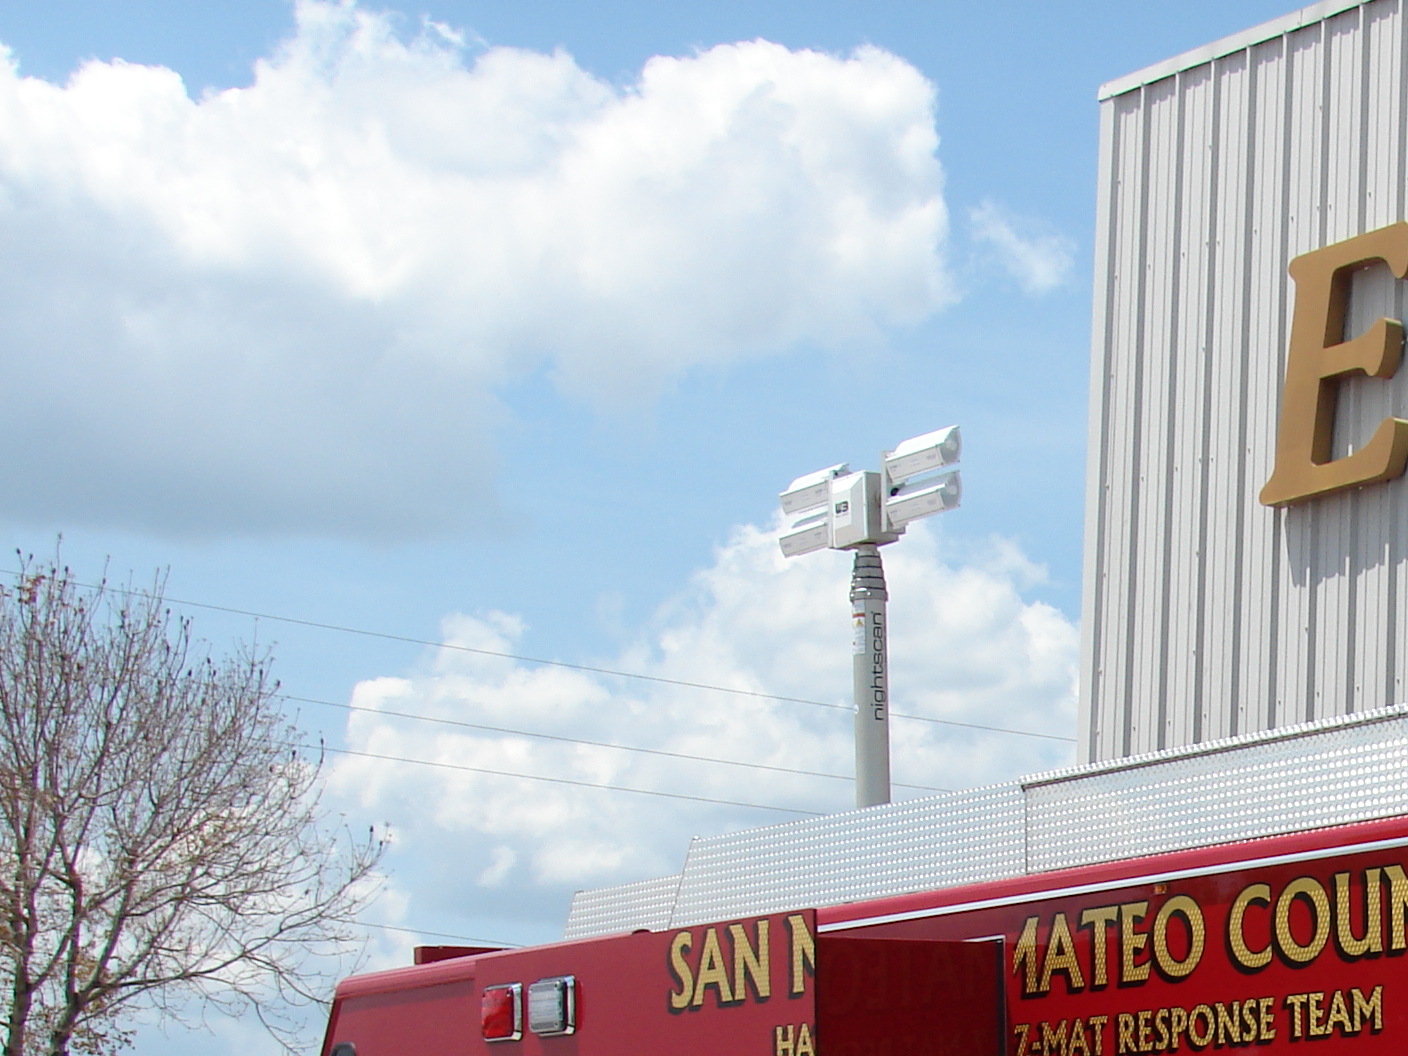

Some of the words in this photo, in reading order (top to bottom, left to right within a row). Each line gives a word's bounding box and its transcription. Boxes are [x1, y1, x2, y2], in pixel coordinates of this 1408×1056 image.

[870, 611, 885, 721] nightscan
[668, 919, 771, 1012] SAN
[1117, 996, 1276, 1055] RESPONSE
[1285, 985, 1384, 1039] TEAM
